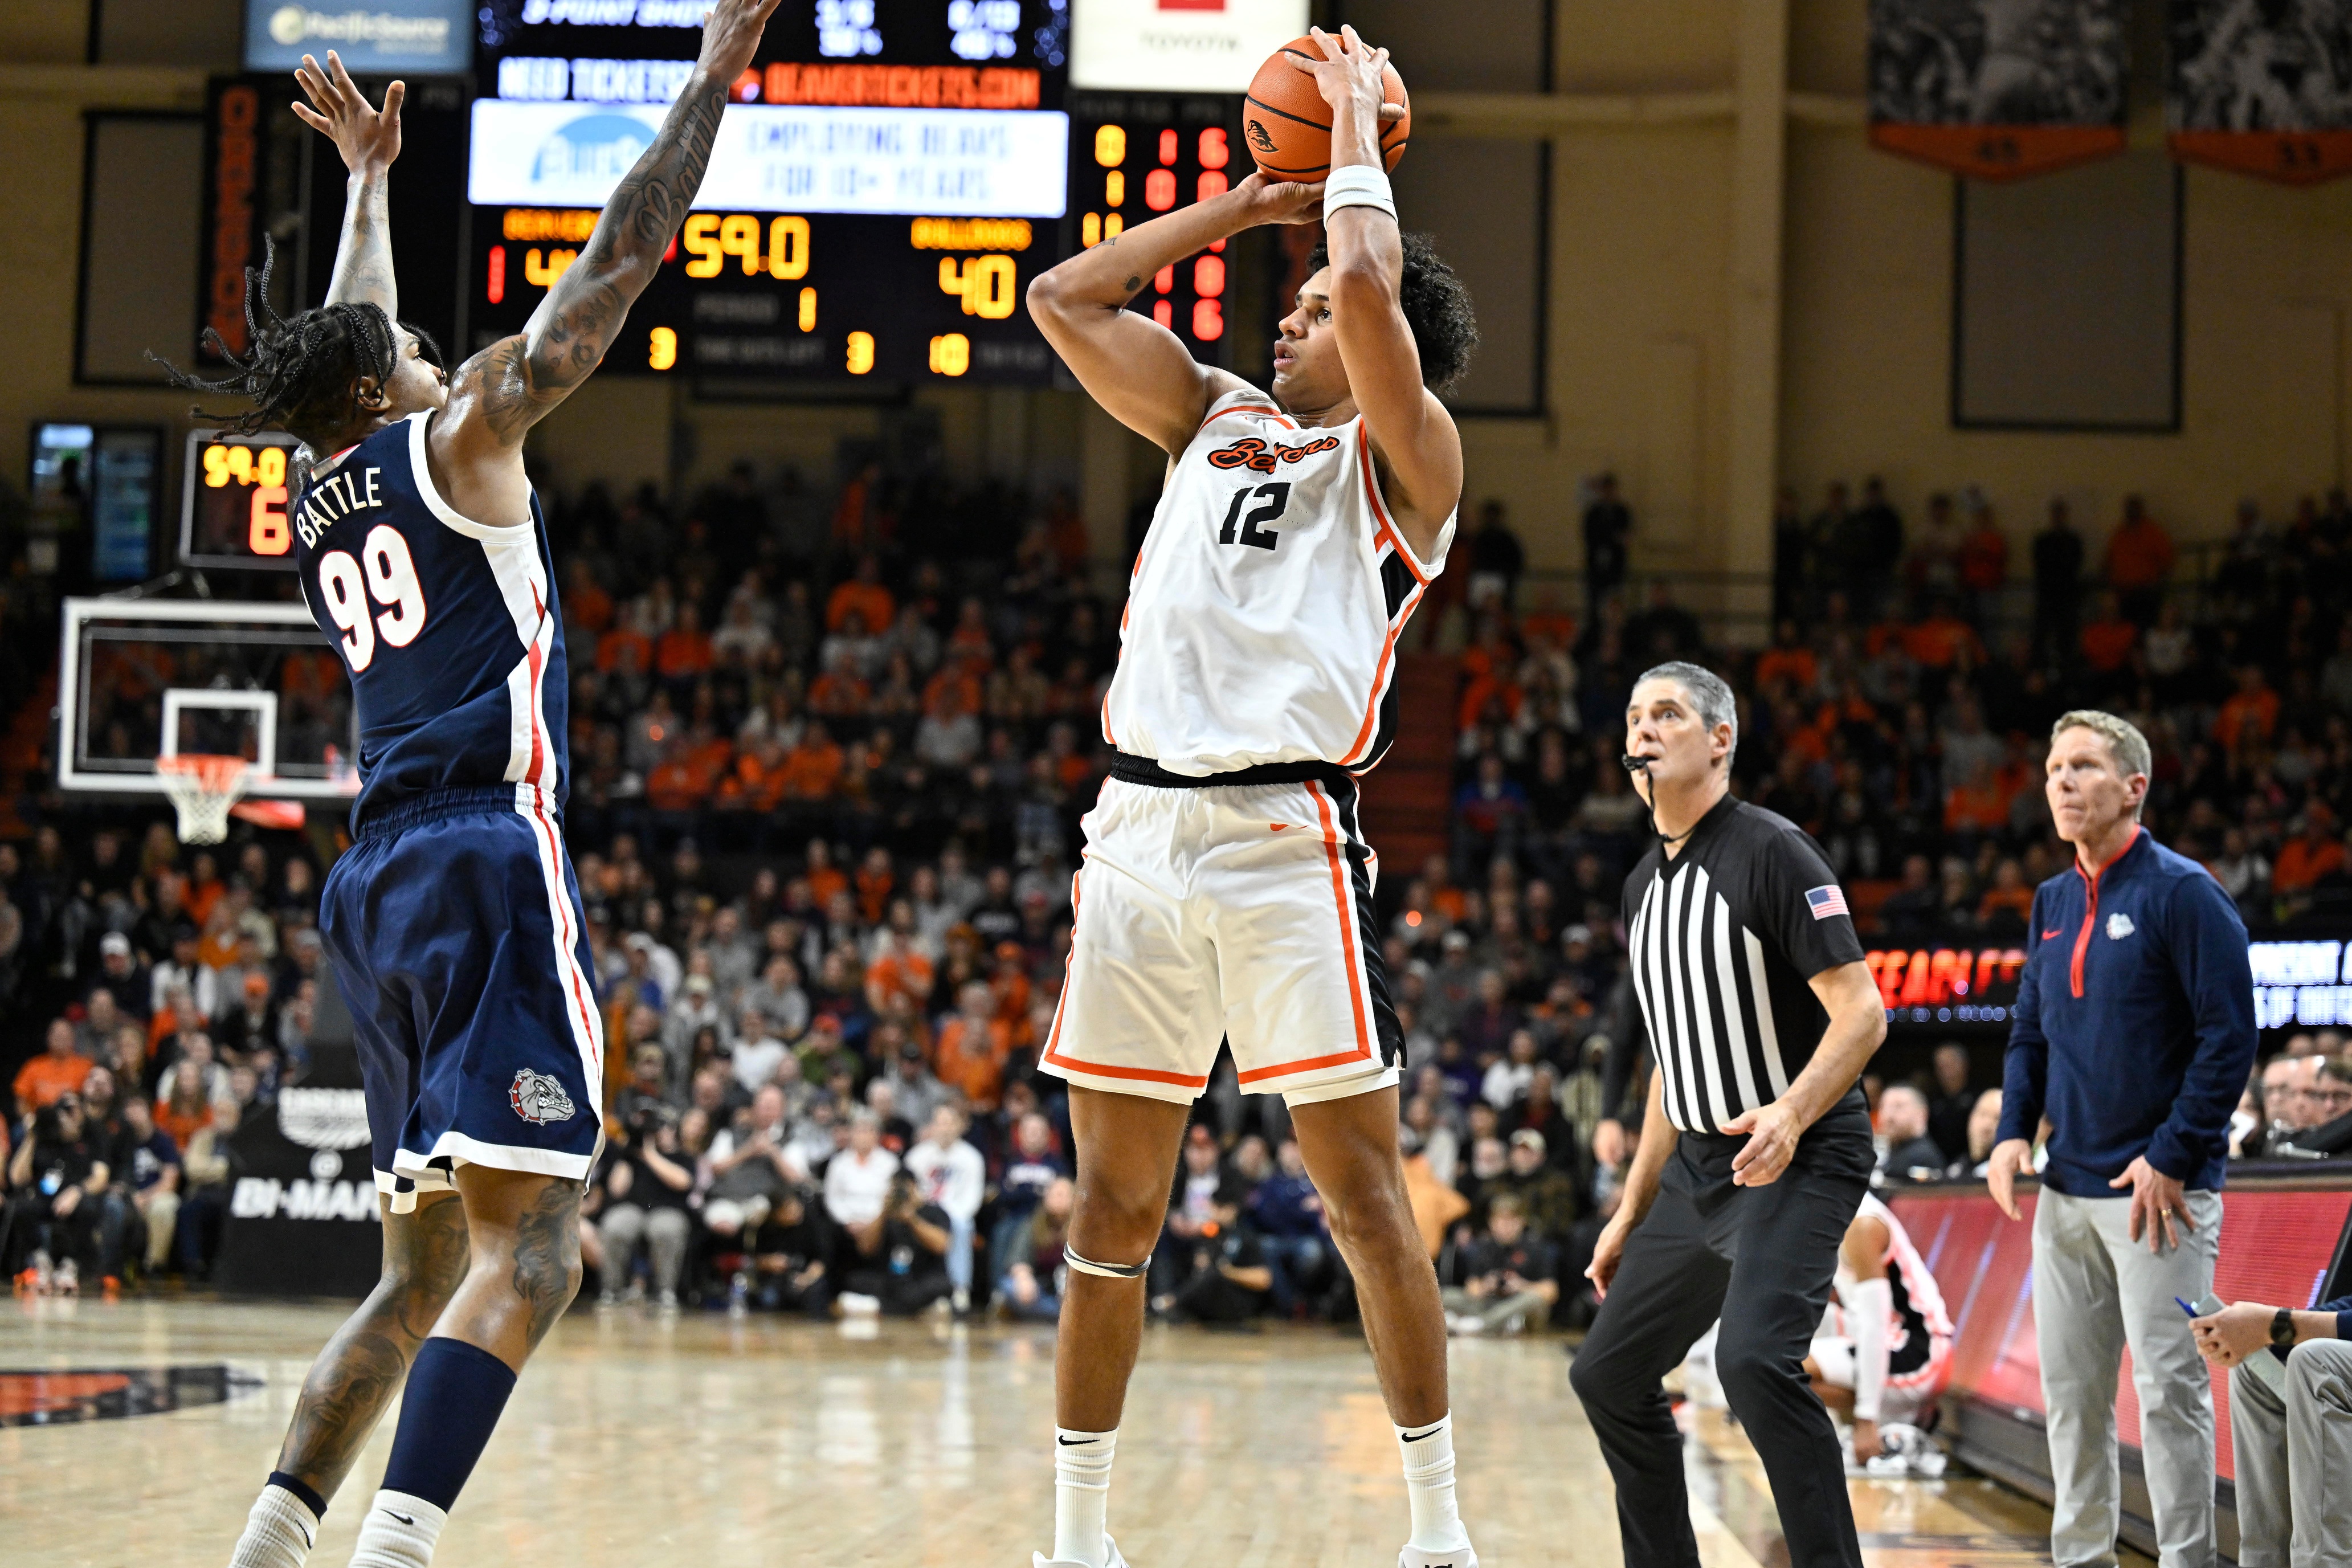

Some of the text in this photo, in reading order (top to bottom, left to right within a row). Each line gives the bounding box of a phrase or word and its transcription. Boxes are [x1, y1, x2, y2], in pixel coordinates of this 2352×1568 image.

[684, 214, 810, 280] 59.0
[939, 255, 1016, 319] 40
[249, 485, 291, 556] 6
[296, 467, 382, 549] BATTLE
[1219, 483, 1291, 551] 12
[318, 524, 427, 673] 99
